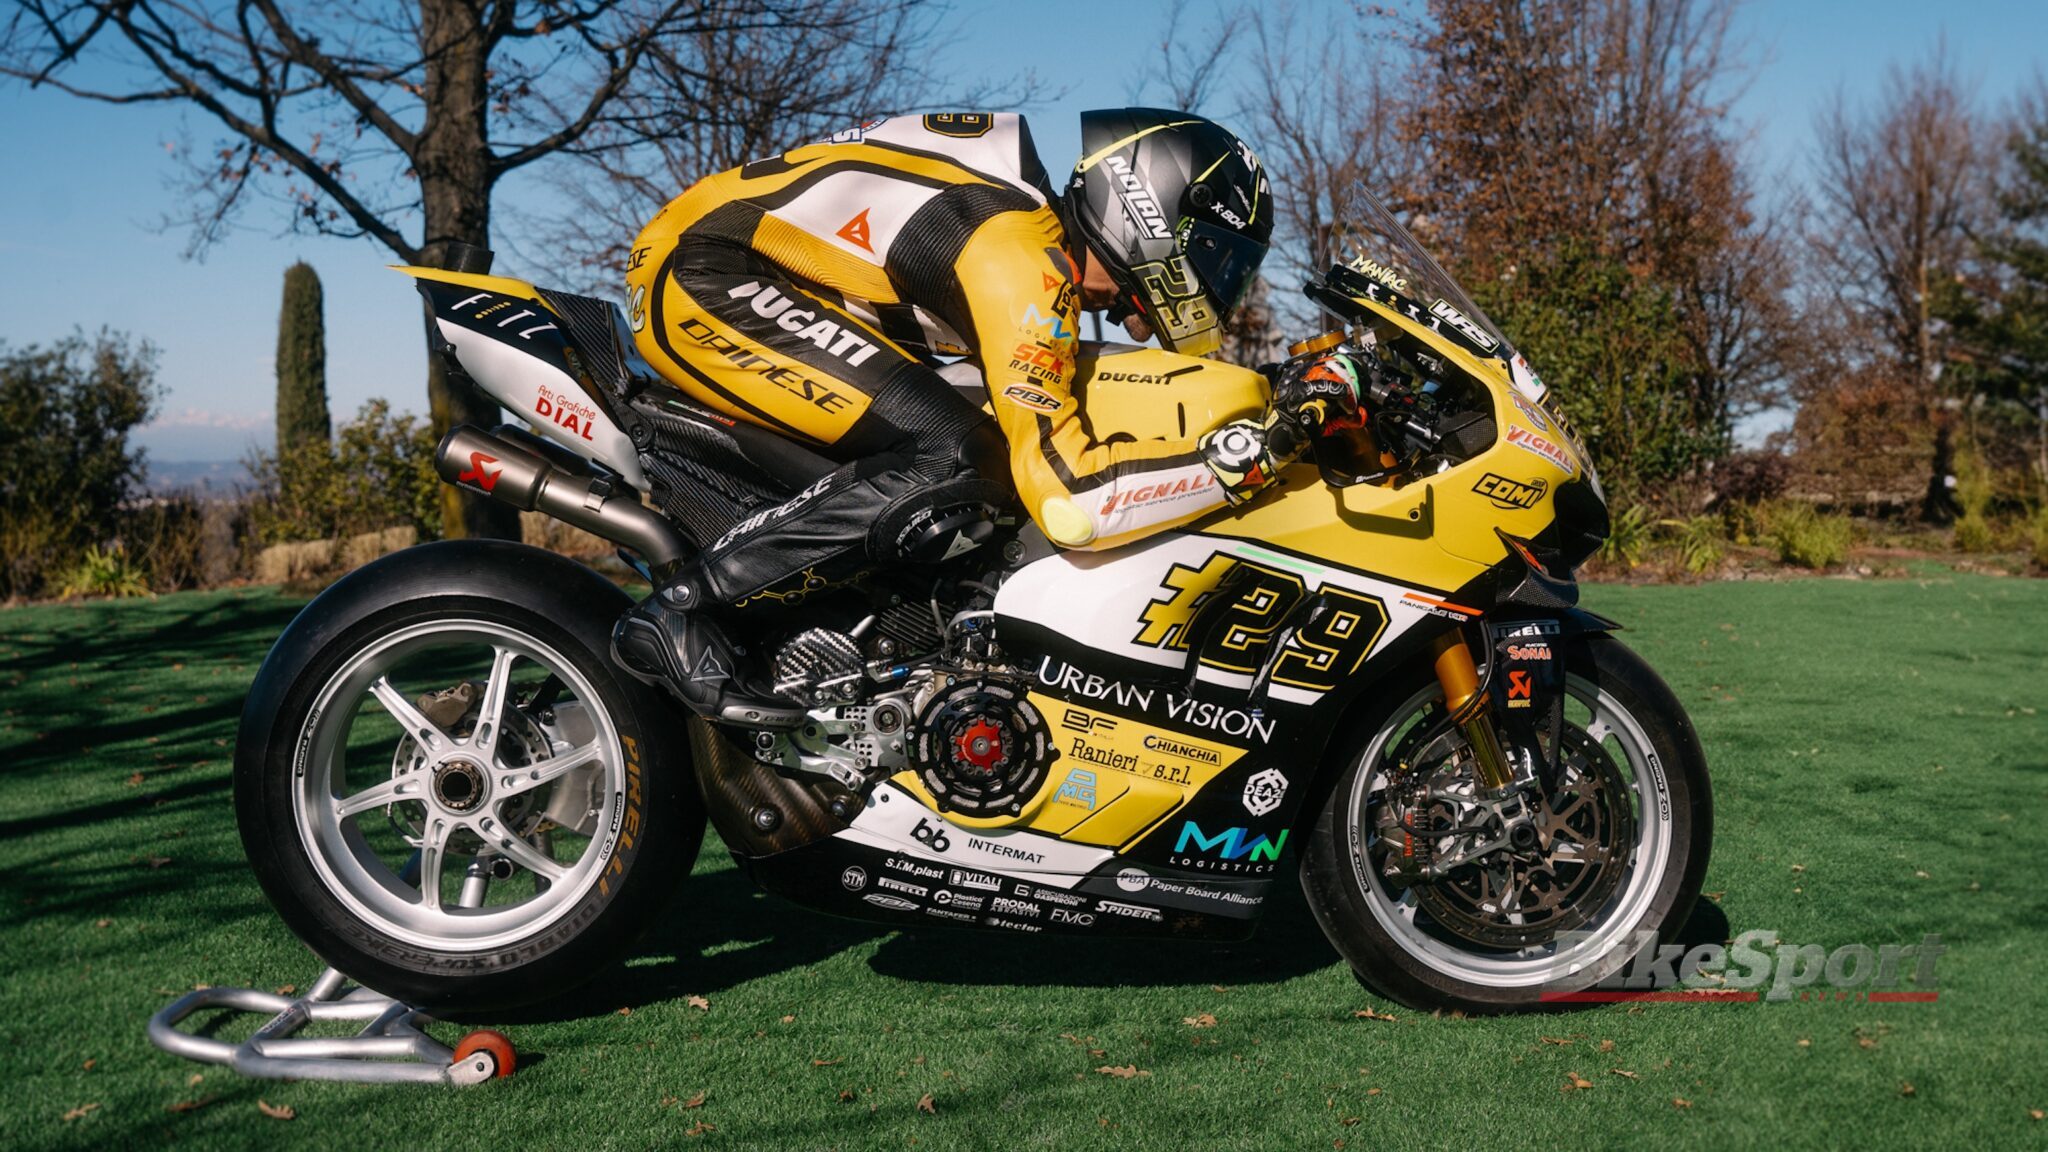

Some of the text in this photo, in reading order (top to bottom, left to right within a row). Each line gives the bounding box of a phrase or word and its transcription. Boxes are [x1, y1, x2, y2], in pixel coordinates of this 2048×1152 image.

[1105, 156, 1173, 239] NOLAN
[678, 318, 854, 415] DAINESE
[1009, 359, 1063, 385] RACING
[1098, 372, 1172, 385] DUCATI
[538, 384, 597, 421] Arti Grafiche
[1004, 386, 1062, 410] PBR
[535, 397, 594, 441] DIAL
[1038, 655, 1277, 745] URBAN VISION
[1069, 737, 1192, 786] Ranieri s.r.l.
[1144, 735, 1219, 764] CHIANCHIA
[600, 735, 641, 896] PIRELLI
[968, 837, 1046, 865] INTERMAT
[1169, 856, 1275, 873] LOGISTICS
[844, 871, 866, 888] STM
[878, 876, 929, 897] PIRELLI
[965, 872, 1002, 886] VITALI
[1150, 879, 1264, 905] Paper Board Alliance
[992, 897, 1041, 913] PRODAL
[1095, 900, 1156, 920] SPIDER
